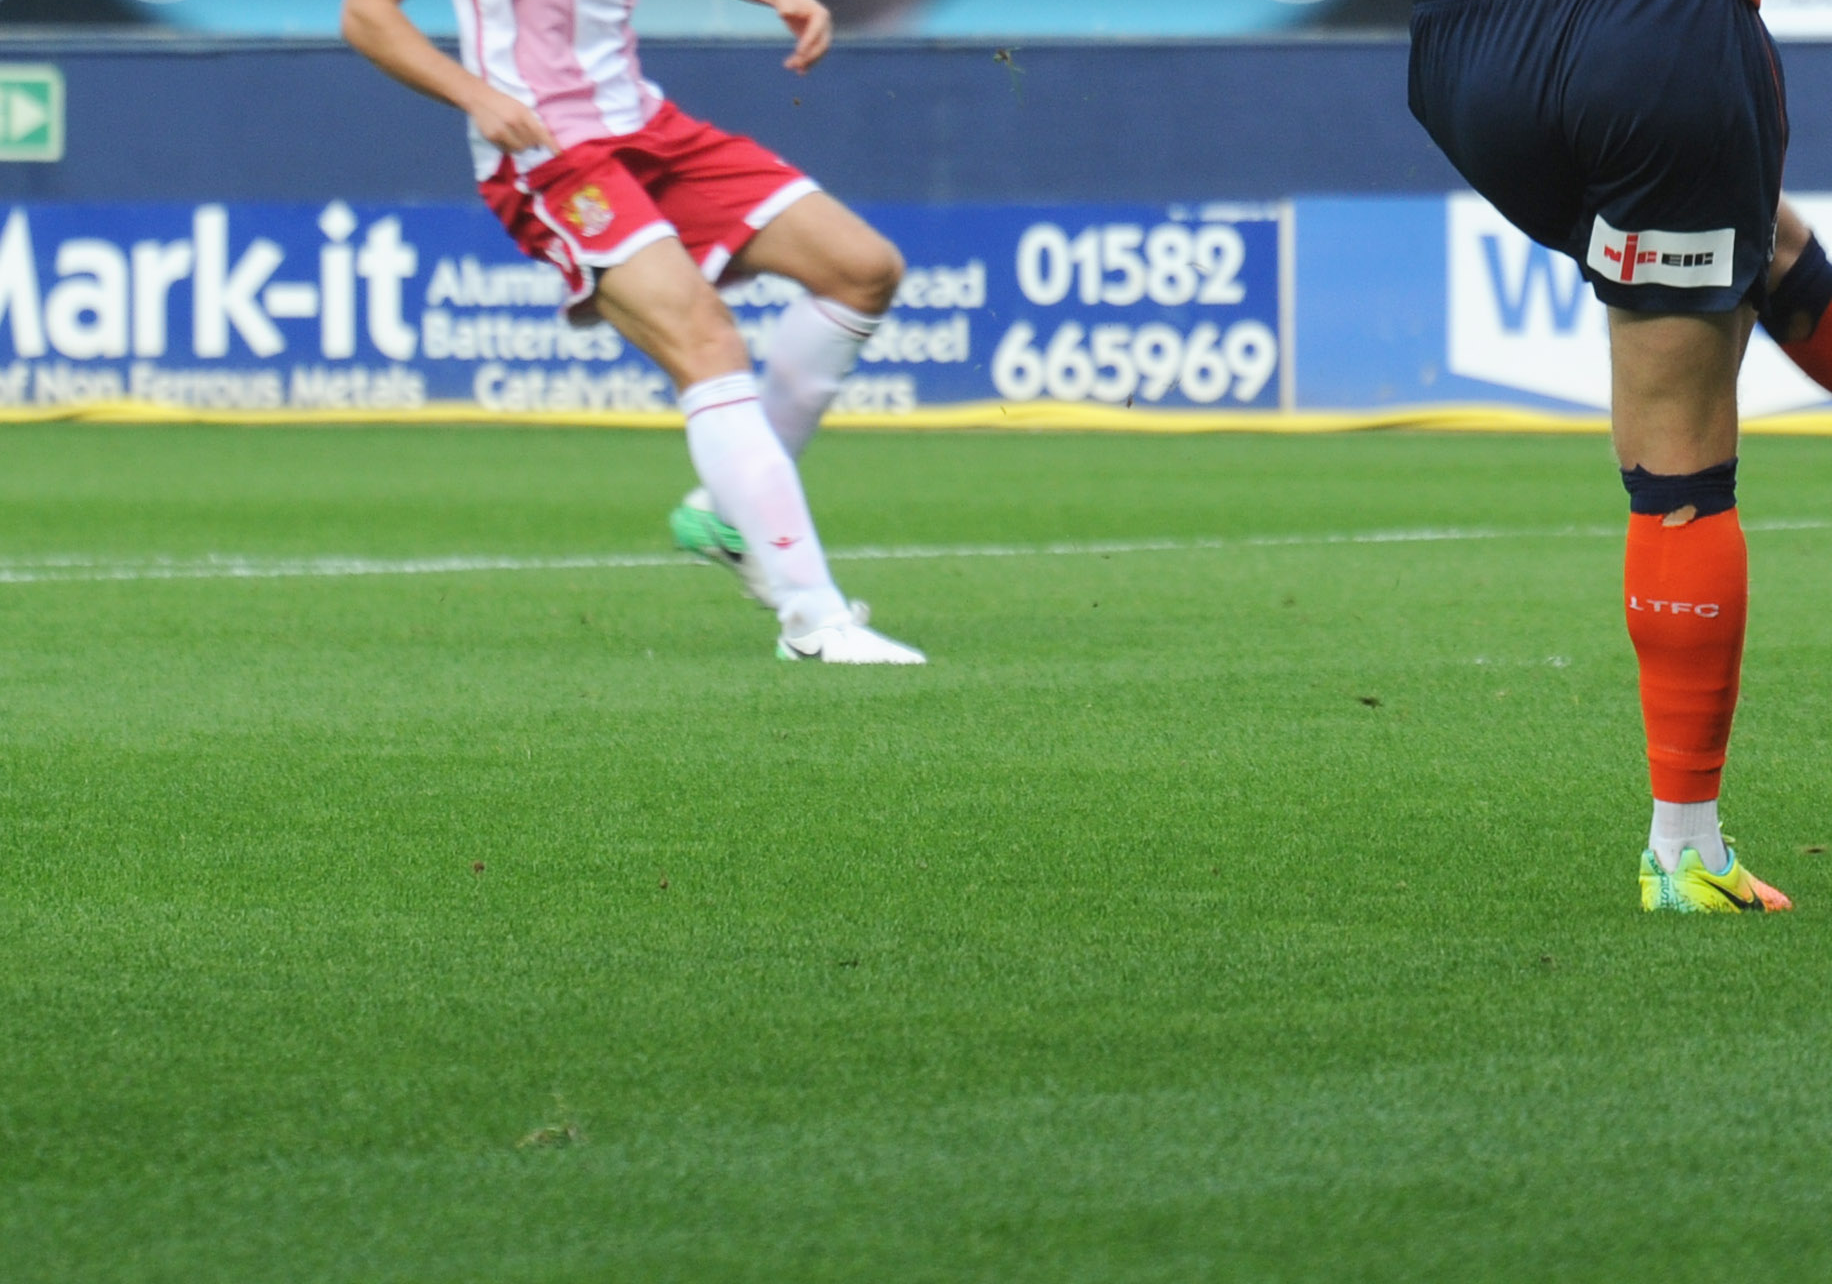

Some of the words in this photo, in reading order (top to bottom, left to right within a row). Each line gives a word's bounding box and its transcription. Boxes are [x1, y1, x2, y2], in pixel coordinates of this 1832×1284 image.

[892, 258, 987, 308] ead
[1015, 222, 1247, 306] 01582
[421, 307, 624, 362] Batteries
[990, 319, 1279, 403] 665969
[290, 365, 427, 409] Metals
[474, 364, 670, 412] Catalytic
[1630, 596, 1720, 618] LTFC
